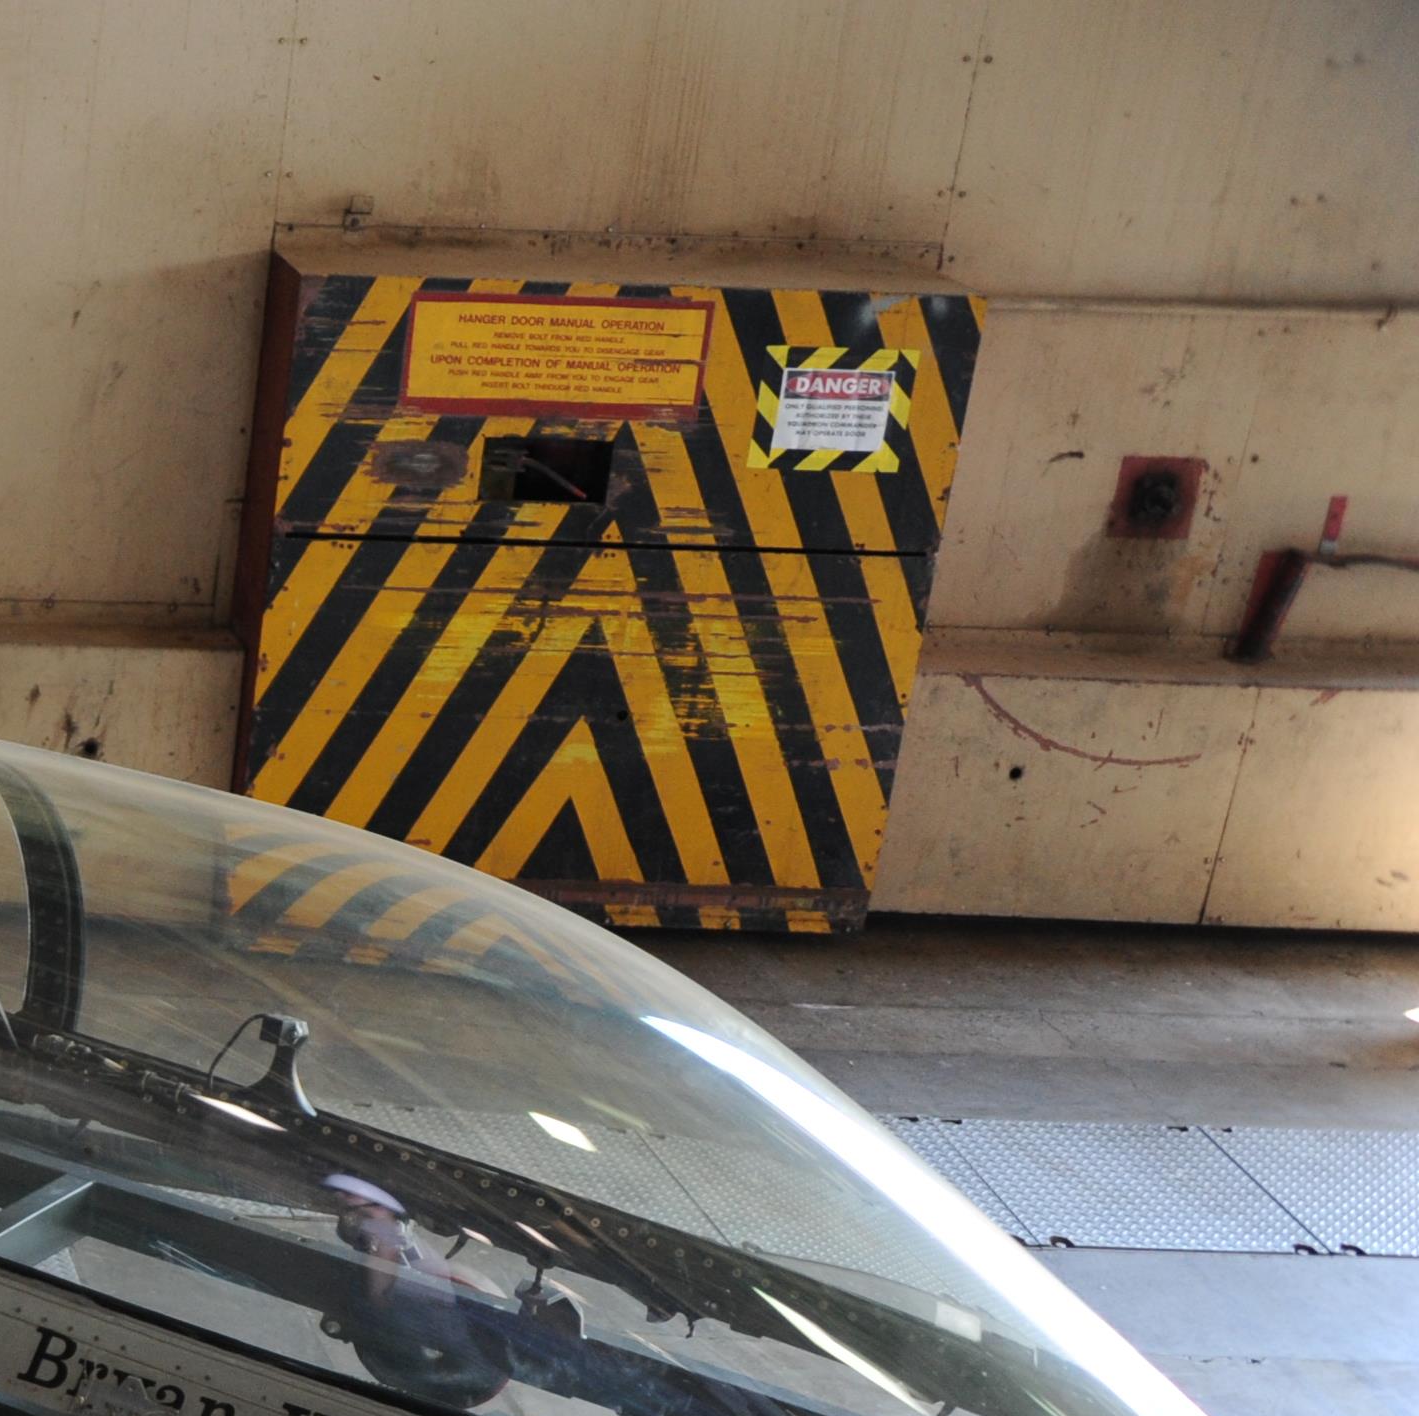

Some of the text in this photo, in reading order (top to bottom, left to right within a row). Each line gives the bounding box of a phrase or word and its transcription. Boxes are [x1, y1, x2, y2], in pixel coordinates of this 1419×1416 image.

[459, 314, 665, 331] HANGER DOOR MANUAL OPERATION
[594, 336, 625, 344] HANDLE
[525, 344, 561, 352] TOWARDS
[584, 346, 594, 354] TO
[430, 354, 681, 374] UPON COMPLETION OF MANUAL OPERATION
[604, 375, 635, 383] ENGAGE
[511, 382, 530, 390] BOLT
[794, 376, 883, 395] DANGER
